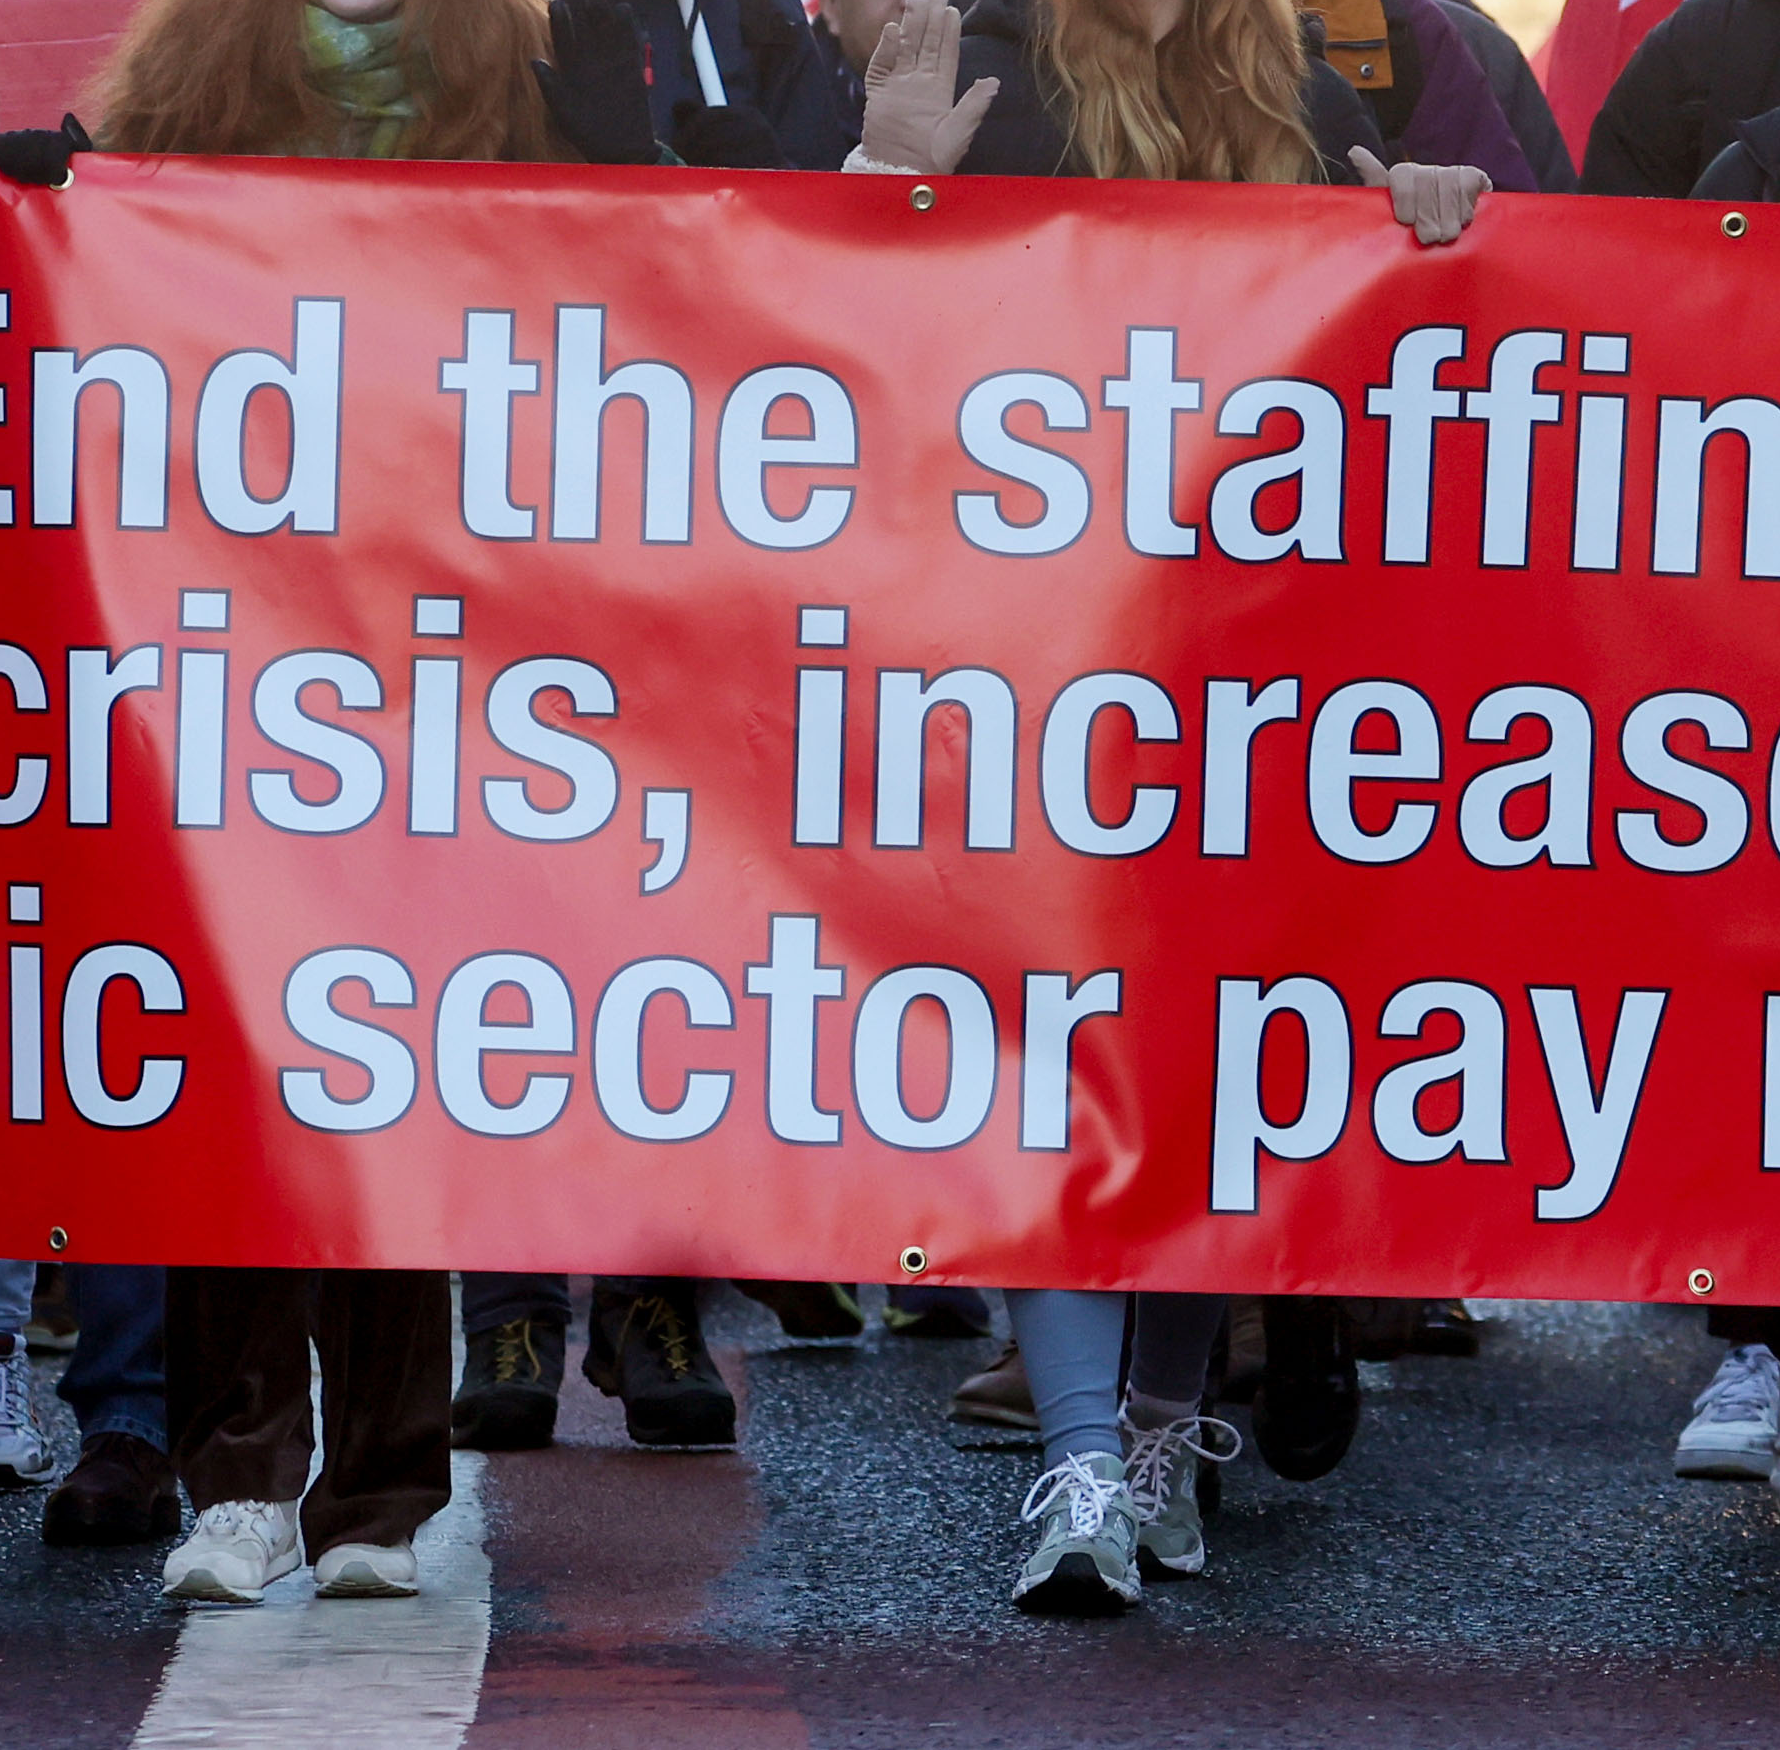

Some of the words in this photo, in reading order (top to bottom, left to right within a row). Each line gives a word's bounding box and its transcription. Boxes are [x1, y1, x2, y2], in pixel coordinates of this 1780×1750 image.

[439, 302, 863, 553] the
[276, 914, 1122, 1156] sector
[1209, 975, 1669, 1222] pay
